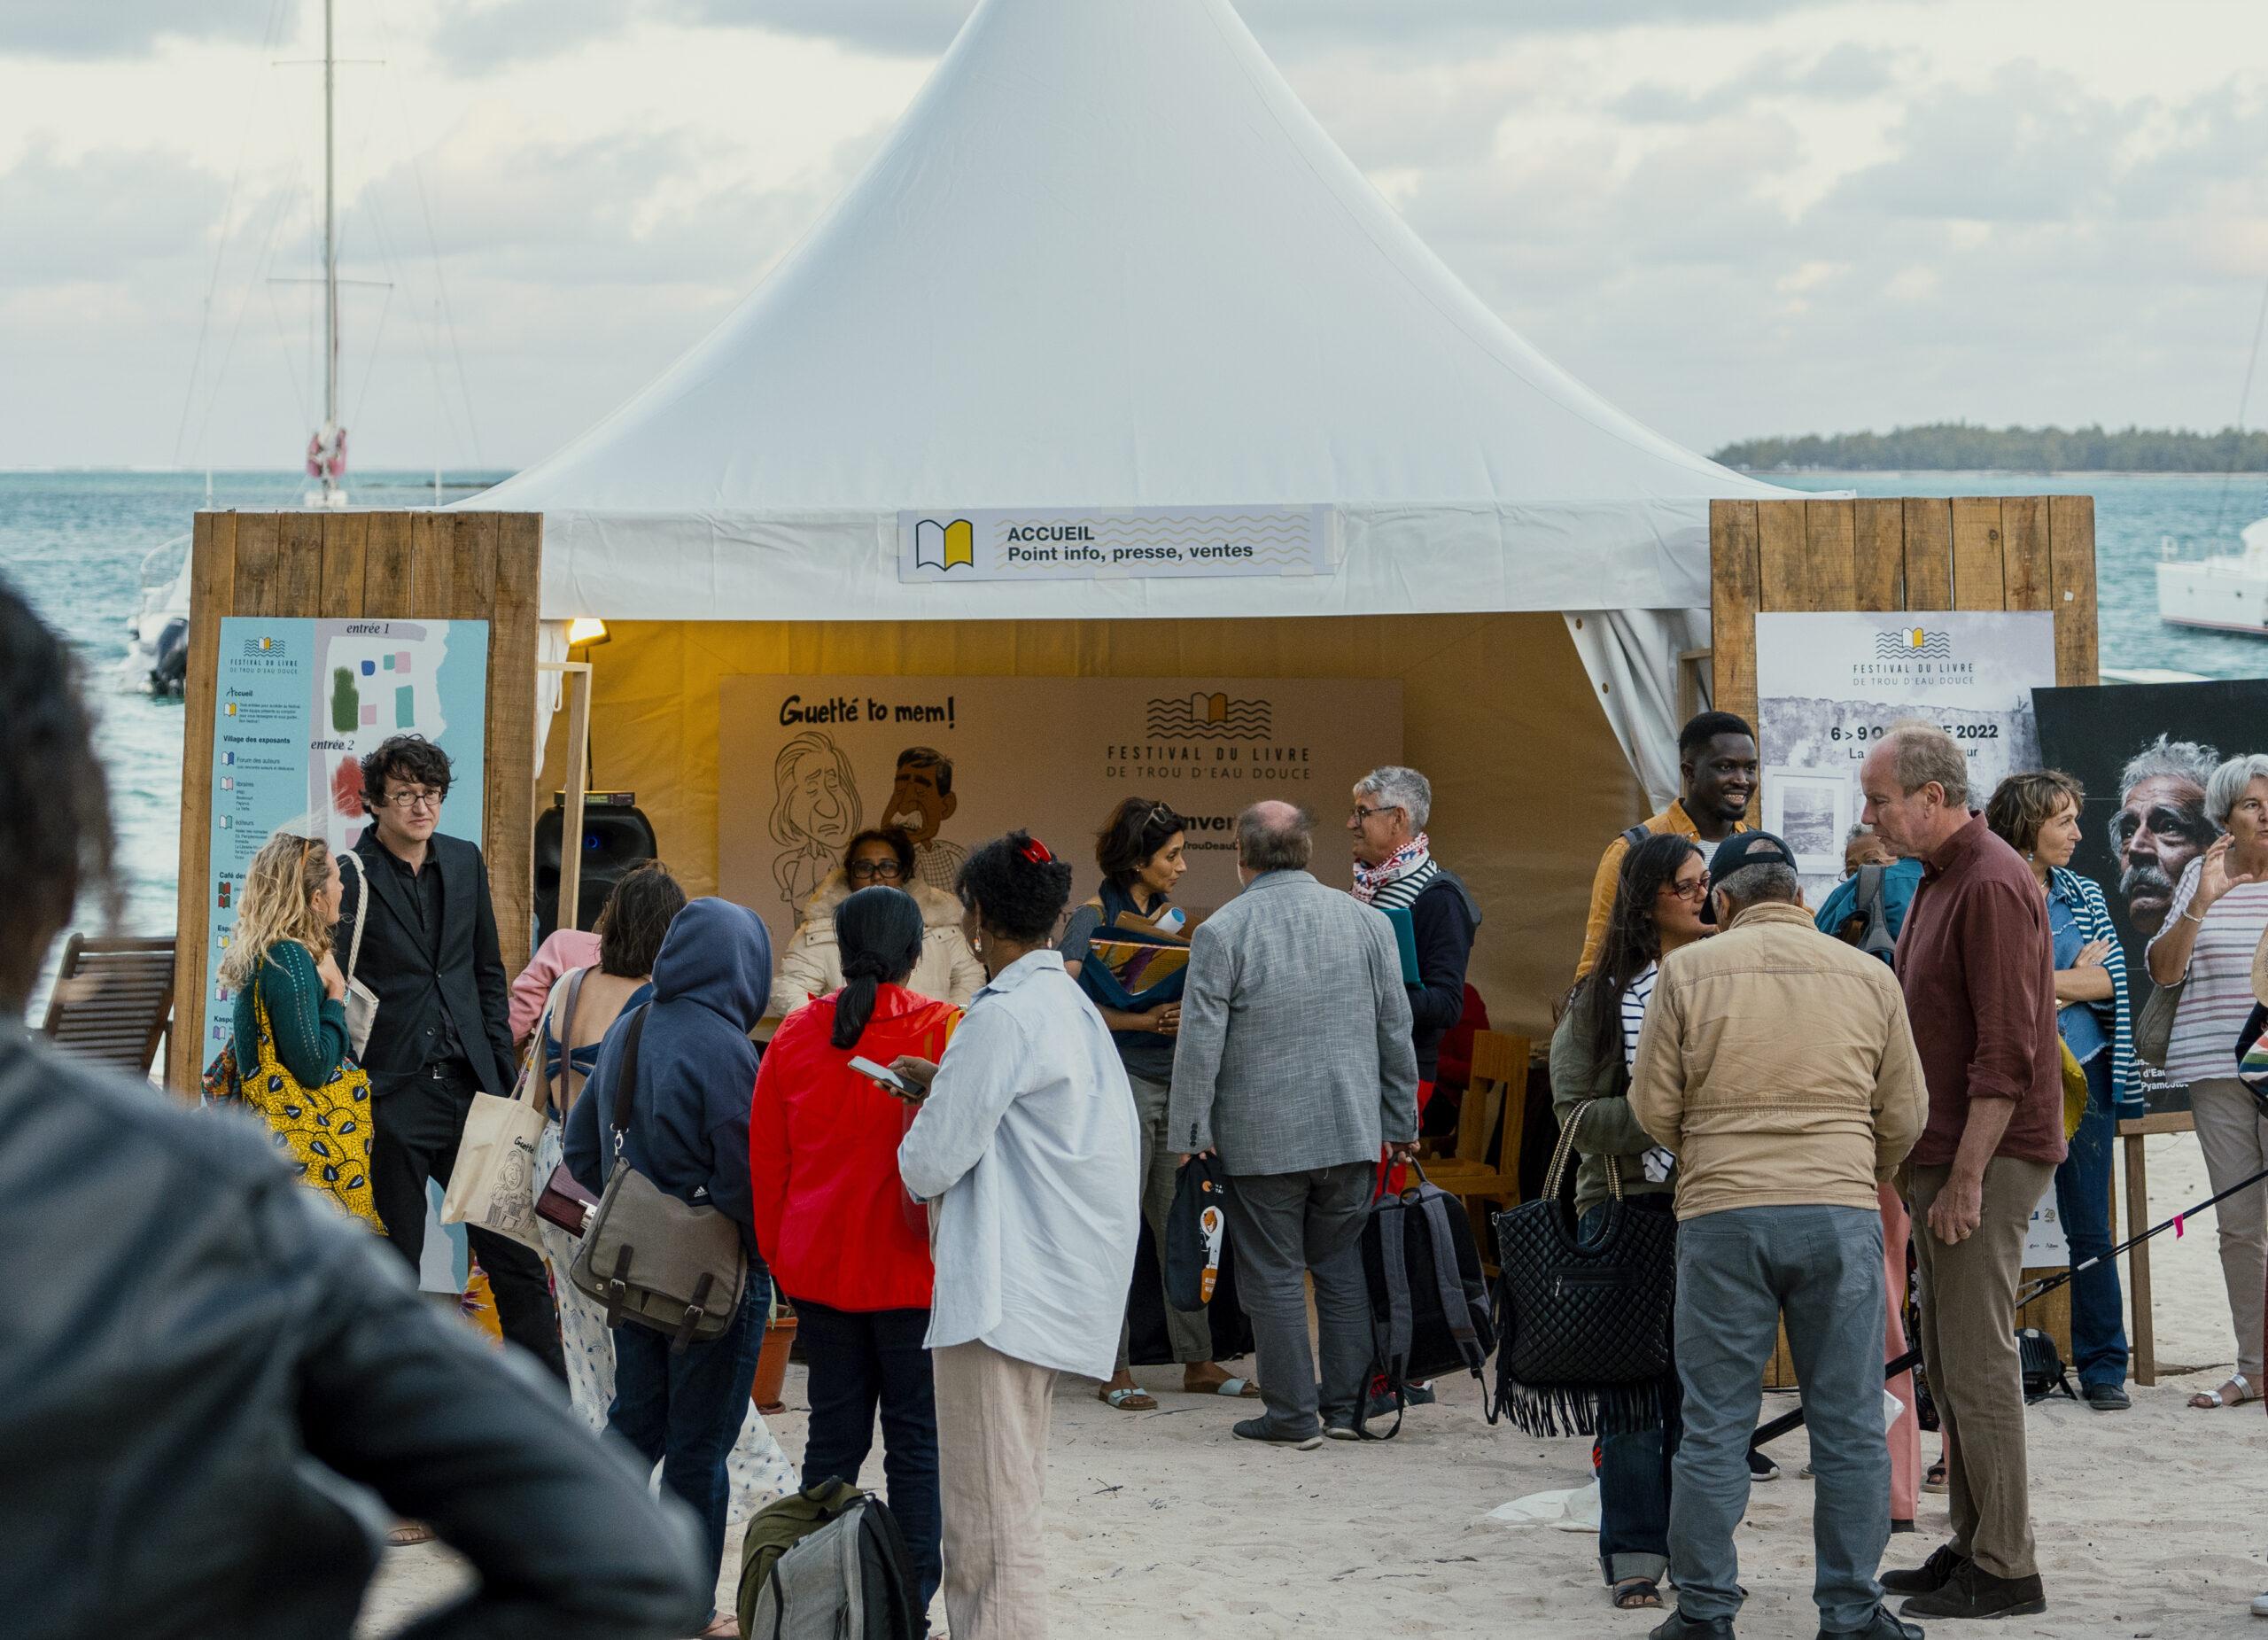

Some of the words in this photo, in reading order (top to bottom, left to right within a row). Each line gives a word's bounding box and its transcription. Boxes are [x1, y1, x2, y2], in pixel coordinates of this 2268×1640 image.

[1006, 525, 1095, 541] ACCUEIL
[1008, 546, 1058, 561] Point
[1064, 545, 1106, 563] info,
[1113, 548, 1183, 563] presse,
[1190, 543, 1253, 558] ventes
[346, 623, 380, 633] entrée
[384, 623, 390, 633] 1
[1853, 665, 1909, 673] FESTIVAL
[1918, 664, 1931, 673] DU
[1939, 663, 1973, 672] LIVRE
[1904, 677, 1934, 686] D'EAU
[1939, 676, 1974, 685] DOUCE
[226, 686, 253, 697] Accueil
[779, 695, 859, 727] Guetté
[867, 696, 889, 722] to
[895, 696, 955, 729] mem!
[223, 735, 245, 743] Village
[1830, 727, 1841, 741] 6
[1857, 726, 1868, 741] 9
[1956, 725, 1999, 739] 2022
[310, 739, 345, 750] entrée
[347, 739, 355, 750] 2
[1107, 745, 1201, 760] FESTIVAL
[1216, 747, 1238, 760] DU
[1253, 748, 1309, 762] LIVRE
[1849, 747, 1865, 759] La
[1107, 766, 1126, 778] DE
[1137, 766, 1181, 778] TROU
[1191, 766, 1243, 779] D'EAU
[1253, 767, 1310, 780] DOUCE
